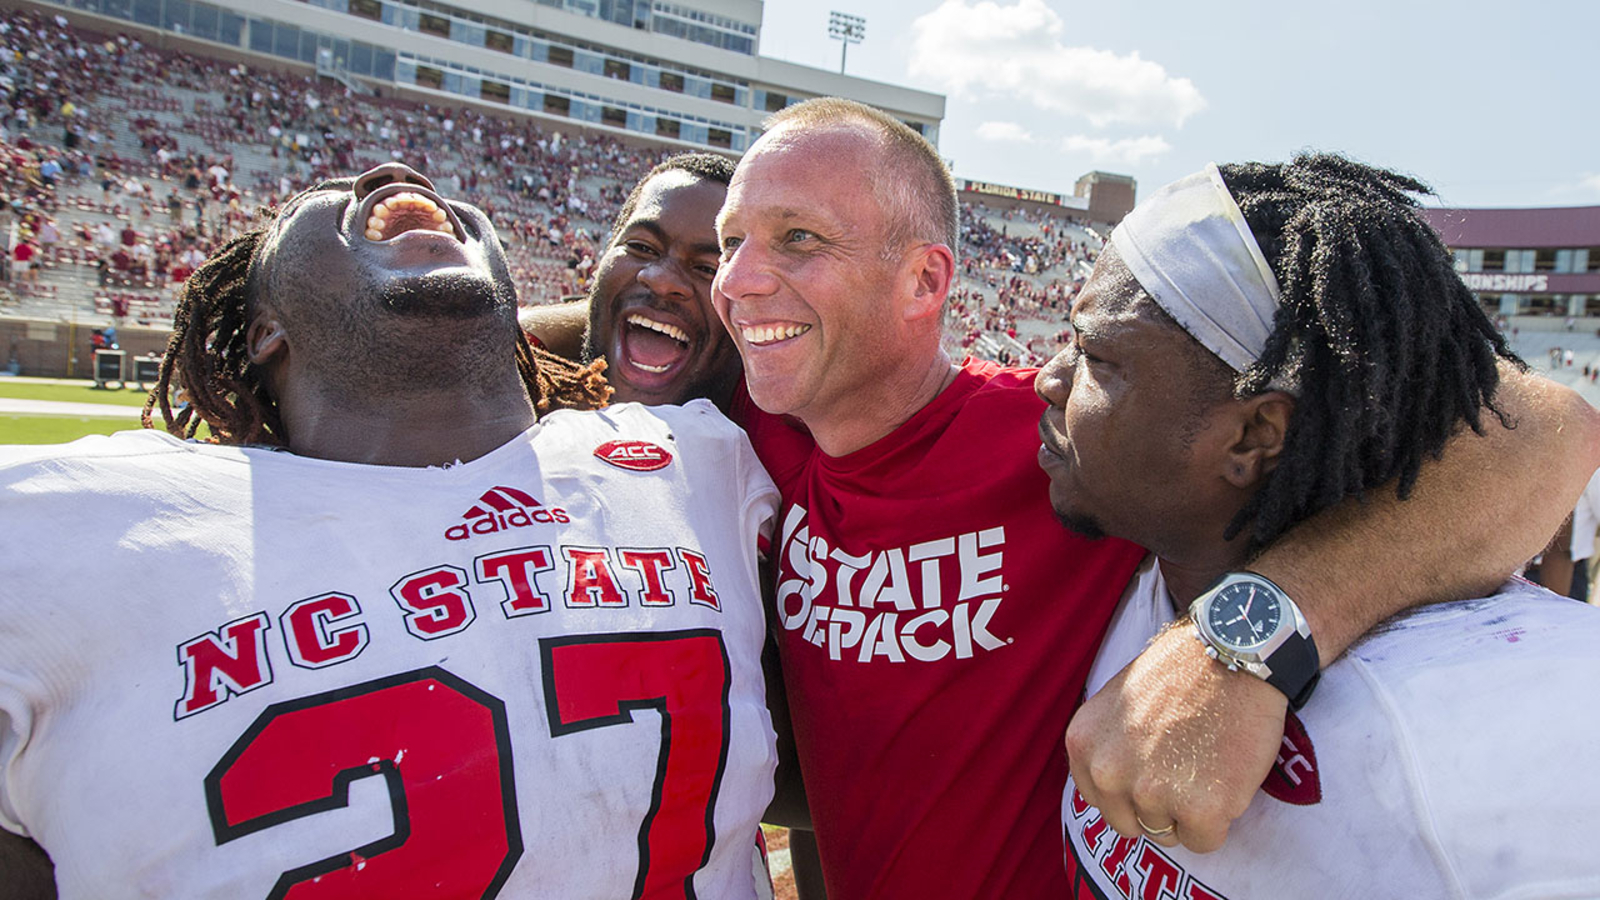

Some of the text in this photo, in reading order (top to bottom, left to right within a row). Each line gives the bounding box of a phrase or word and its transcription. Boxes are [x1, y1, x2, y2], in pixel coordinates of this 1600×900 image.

[970, 181, 1055, 204] FLORIDA STATE
[608, 445, 662, 460] ACC
[445, 506, 571, 541] adidas
[174, 591, 369, 722] NC
[389, 545, 723, 641] STATE
[204, 628, 731, 900] 27
